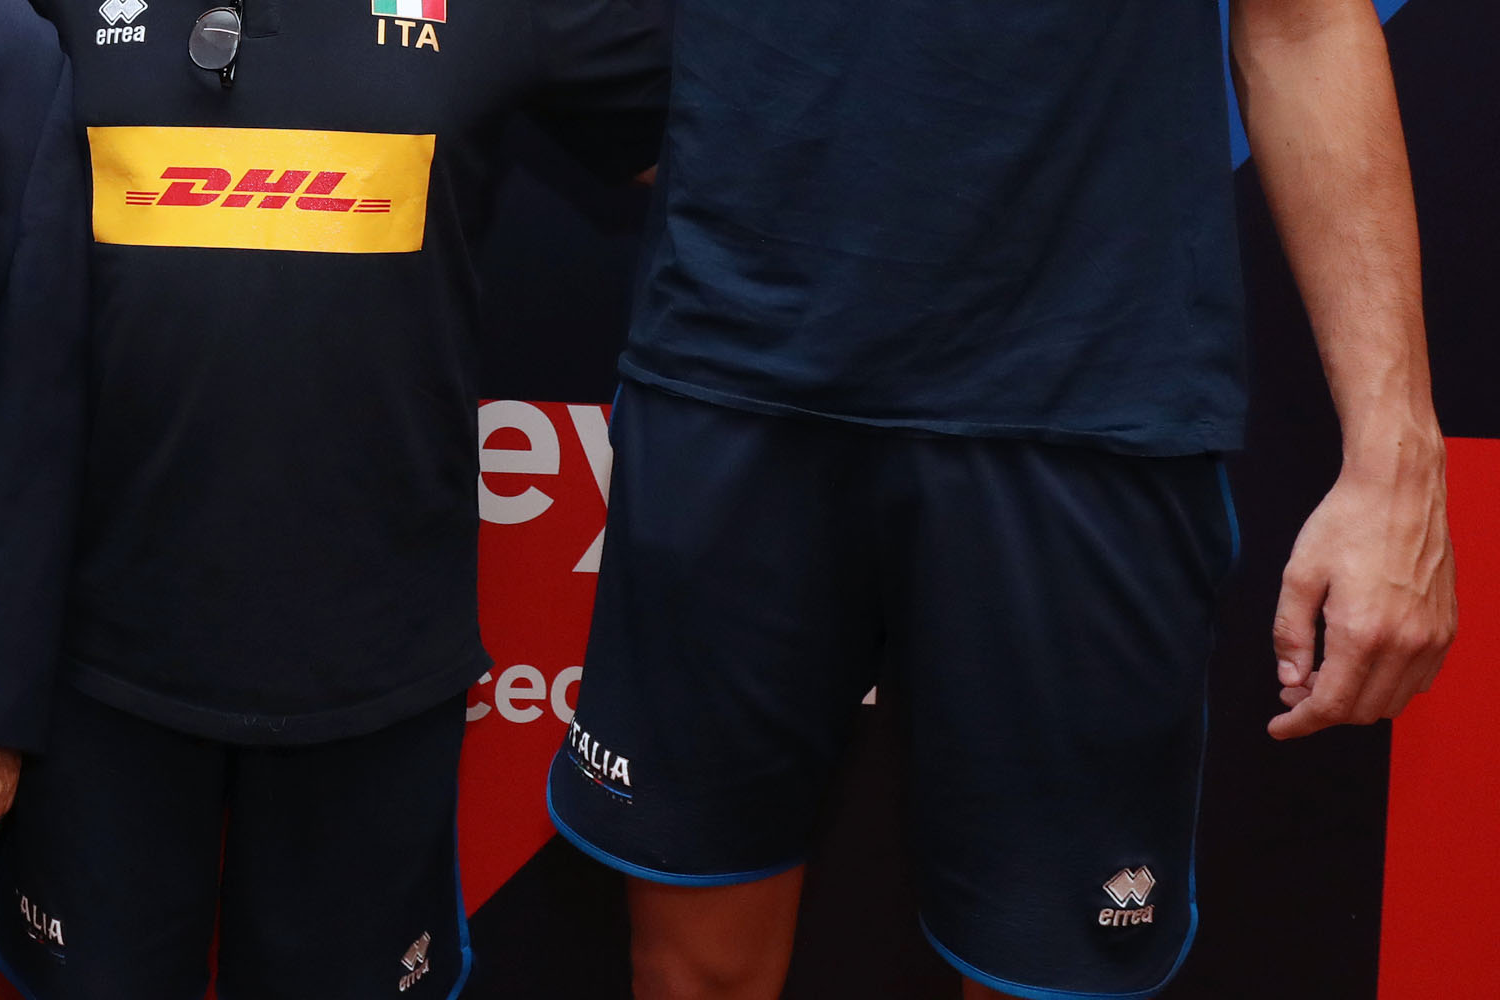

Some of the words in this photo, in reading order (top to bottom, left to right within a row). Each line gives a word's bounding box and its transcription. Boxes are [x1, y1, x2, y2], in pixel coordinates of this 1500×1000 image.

[377, 18, 440, 53] ITA
[156, 166, 358, 213] DHL
[17, 893, 65, 946] ALIA
